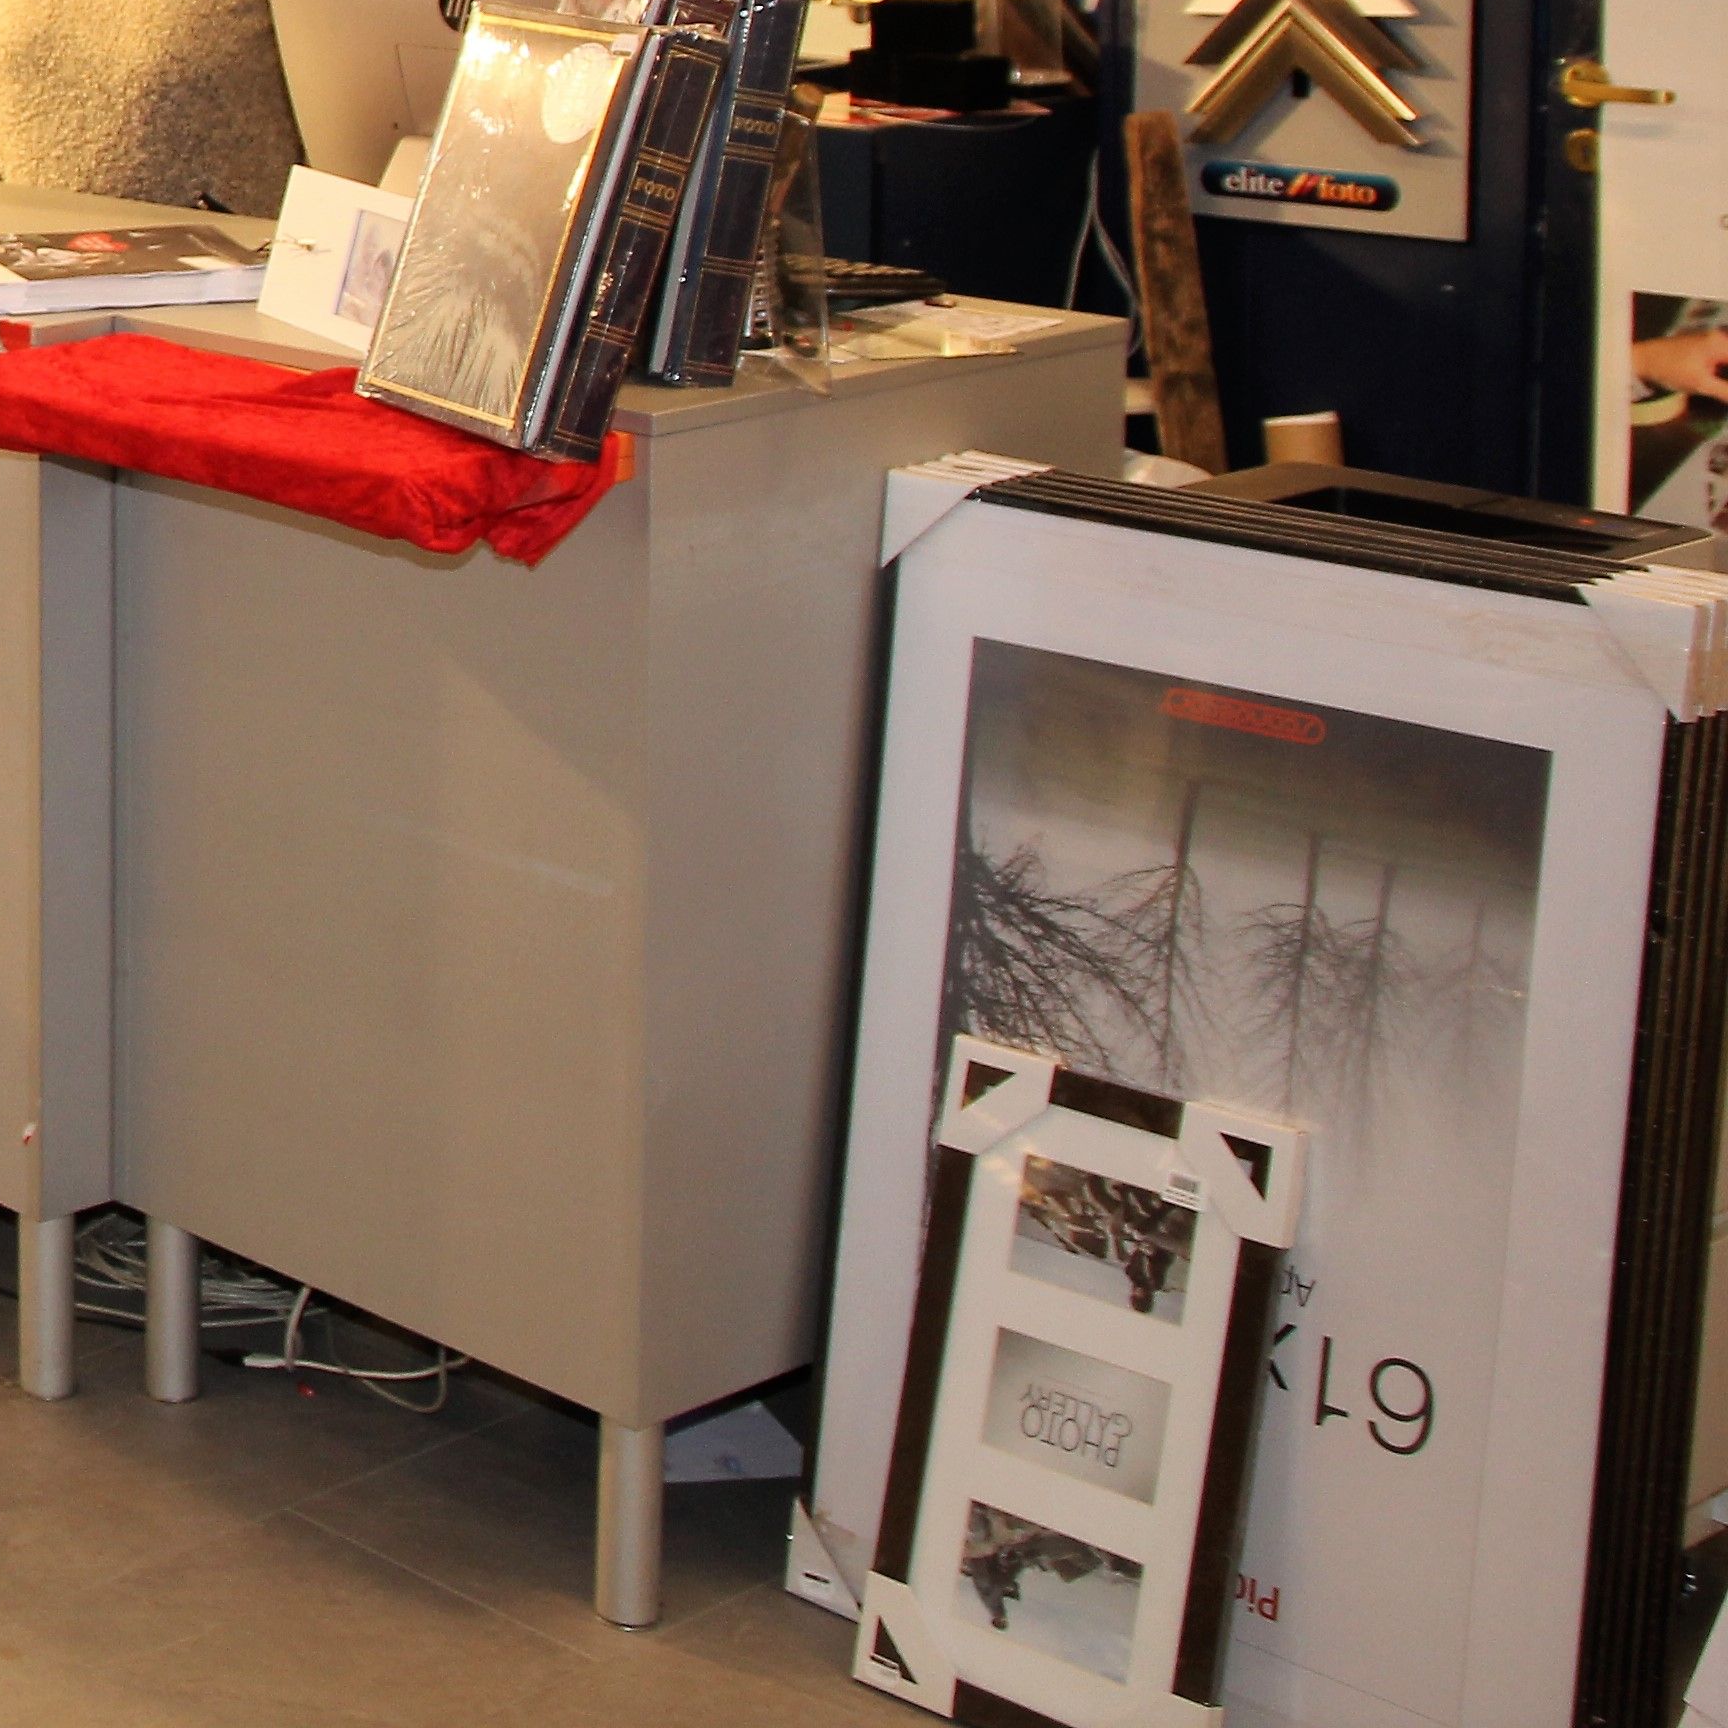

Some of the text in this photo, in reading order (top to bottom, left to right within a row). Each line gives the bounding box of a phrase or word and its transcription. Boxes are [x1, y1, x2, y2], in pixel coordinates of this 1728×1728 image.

[732, 116, 777, 135] FOTO
[632, 176, 677, 201] FOTO
[1224, 165, 1379, 206] elite foto
[1021, 1403, 1120, 1468] PHOTO
